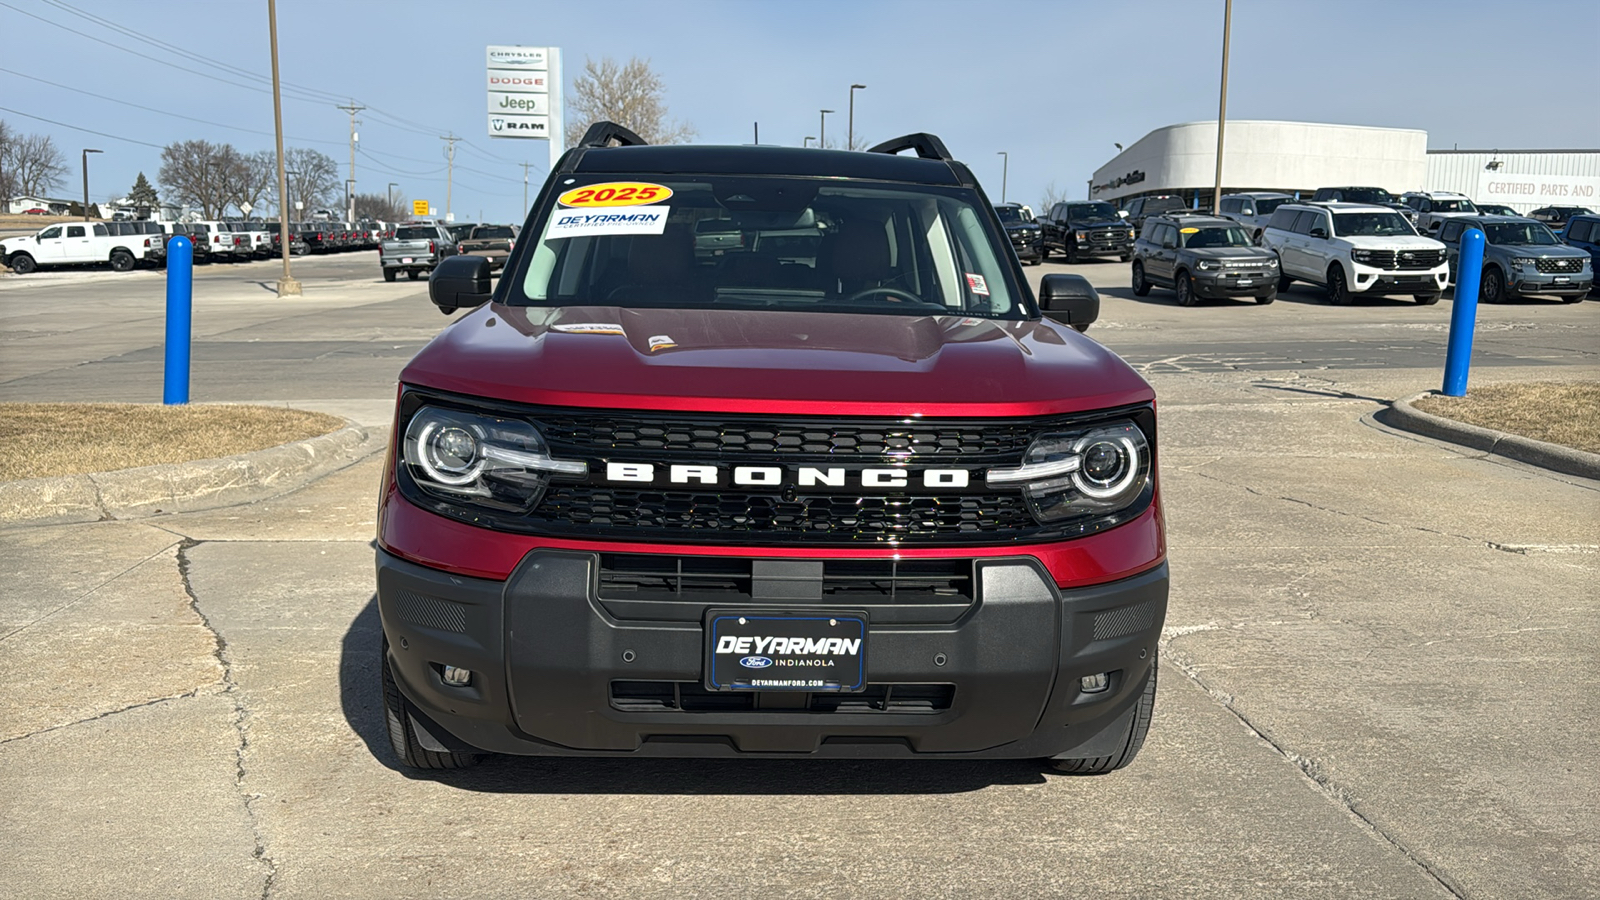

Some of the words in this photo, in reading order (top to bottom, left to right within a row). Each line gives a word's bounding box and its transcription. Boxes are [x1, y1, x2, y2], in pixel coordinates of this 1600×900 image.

[490, 77, 544, 85] DODGE
[499, 95, 535, 111] Jeep
[507, 122, 545, 130] RAM
[1488, 181, 1535, 195] CERTIFIED
[1540, 183, 1568, 196] PARTS
[1572, 185, 1594, 197] AND
[570, 187, 660, 204] 2025
[557, 214, 660, 225] DEYARMAN
[563, 221, 605, 229] CERTIFIED
[606, 462, 969, 488] BRONCO
[715, 636, 861, 655] DEYARMAN
[746, 657, 766, 667] Ford
[775, 659, 835, 667] INDIANOLA
[751, 679, 824, 687] DEYARMANFORD.COM
